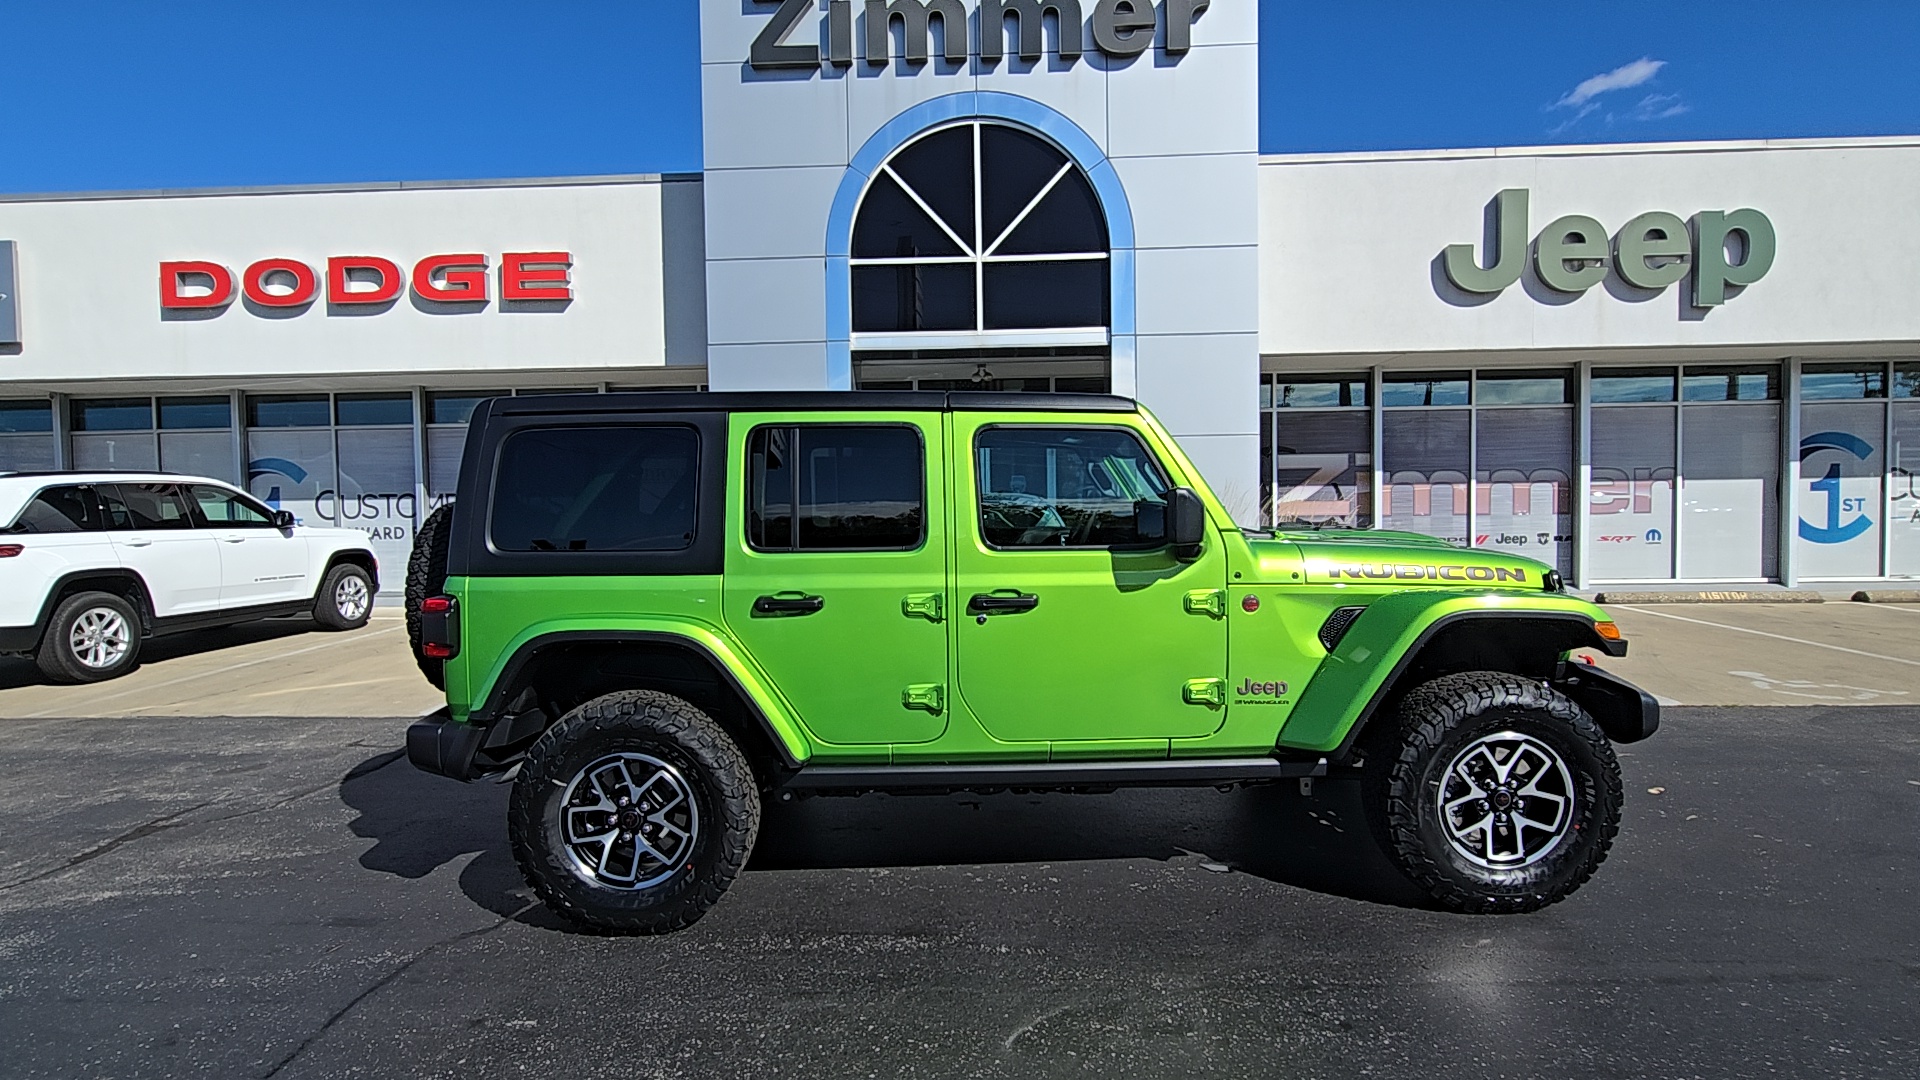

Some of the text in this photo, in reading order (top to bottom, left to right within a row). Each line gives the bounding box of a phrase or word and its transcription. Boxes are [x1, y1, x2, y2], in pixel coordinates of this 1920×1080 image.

[749, 0, 1213, 68] Zimmer
[1443, 188, 1776, 306] Jeep
[159, 252, 572, 310] DODGE
[1276, 452, 1684, 517] Zimmer
[1495, 533, 1528, 546] Jeep
[1596, 535, 1637, 544] SRT
[1329, 563, 1527, 582] RUBICON
[1236, 677, 1289, 699] Jeep
